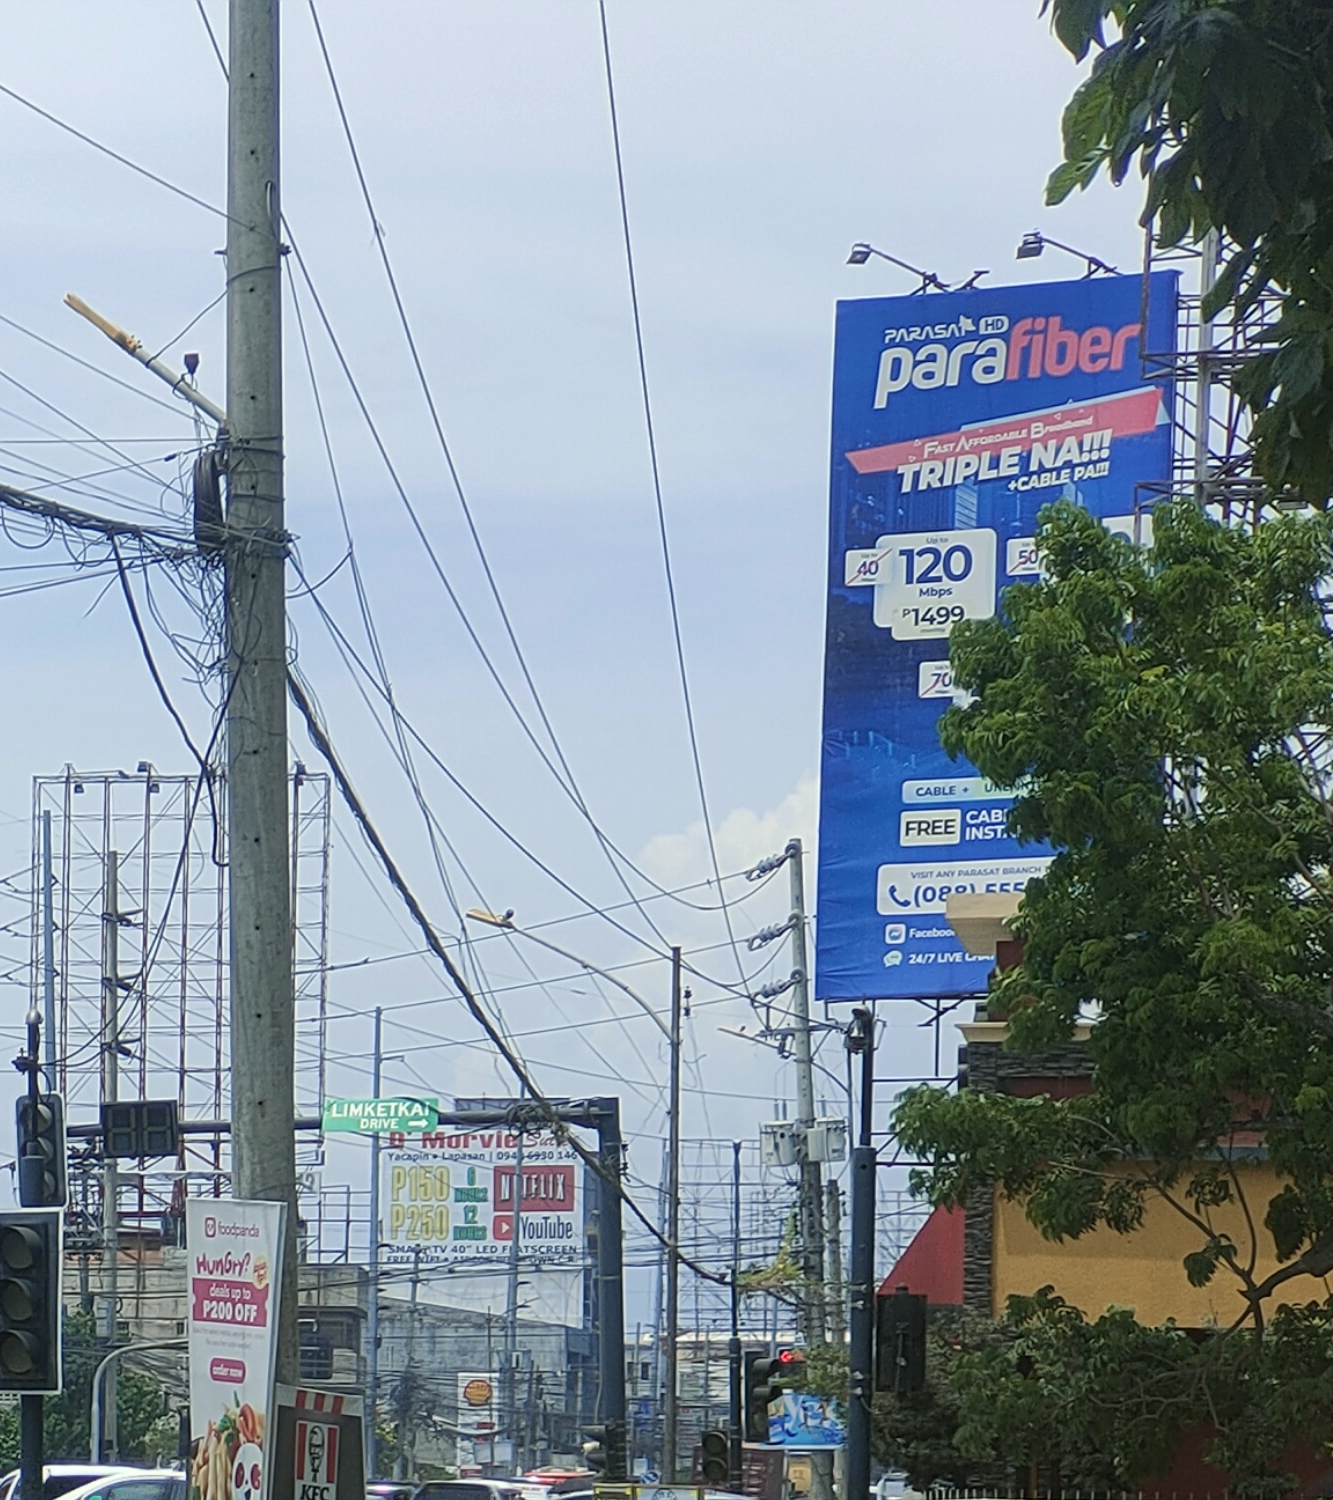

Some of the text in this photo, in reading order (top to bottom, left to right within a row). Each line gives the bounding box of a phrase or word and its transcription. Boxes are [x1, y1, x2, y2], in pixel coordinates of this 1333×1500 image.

[983, 319, 1004, 332] HD
[873, 315, 1143, 410] parafiber
[897, 428, 1113, 495] TRIPLE NA!!!
[898, 544, 973, 586] 120
[1018, 549, 1039, 565] 50
[857, 559, 879, 576] 40
[918, 587, 953, 599] Mbps
[930, 672, 953, 689] 70
[915, 785, 956, 797] CABLE
[904, 818, 957, 837] FREE
[910, 866, 1042, 879] VISIT ANY PARASAT BRANCH
[909, 928, 956, 939] Faceboo
[908, 953, 934, 965] 24/7
[937, 952, 963, 963] LIVE
[331, 1102, 431, 1118] LIMKETKAI
[359, 1118, 399, 1130] DRIVE
[388, 1152, 429, 1162] Yacapin
[442, 1152, 485, 1162] Lapasan
[391, 1165, 477, 1203] P150 6
[217, 1220, 260, 1239] foodpanda
[390, 1204, 479, 1241] P250 12
[521, 1216, 574, 1240] YouTube
[476, 1244, 498, 1254] LED
[209, 1283, 252, 1300] deals up to
[202, 1300, 258, 1322] P200 OFF
